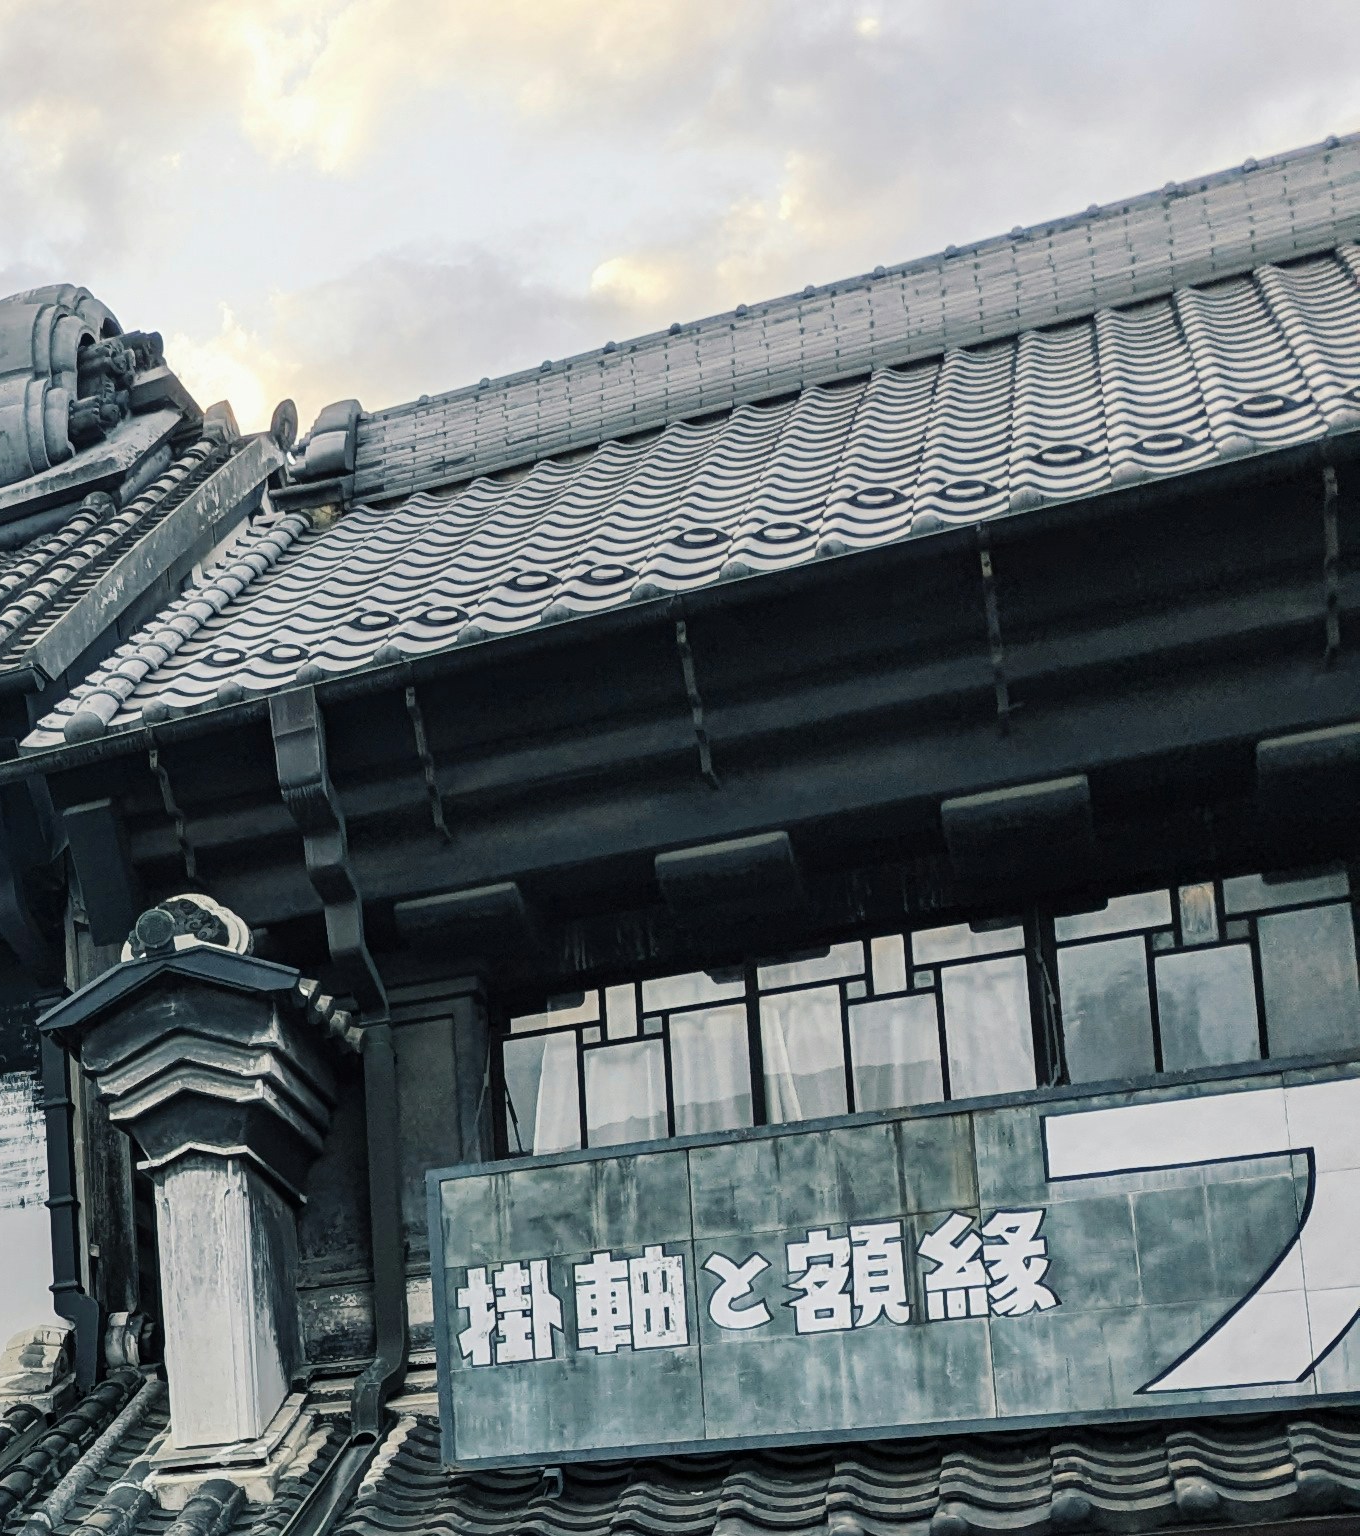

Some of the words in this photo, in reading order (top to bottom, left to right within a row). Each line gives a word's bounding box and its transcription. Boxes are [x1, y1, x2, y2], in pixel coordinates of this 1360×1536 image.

[456, 1206, 1064, 1368] 掛軸と額縁
